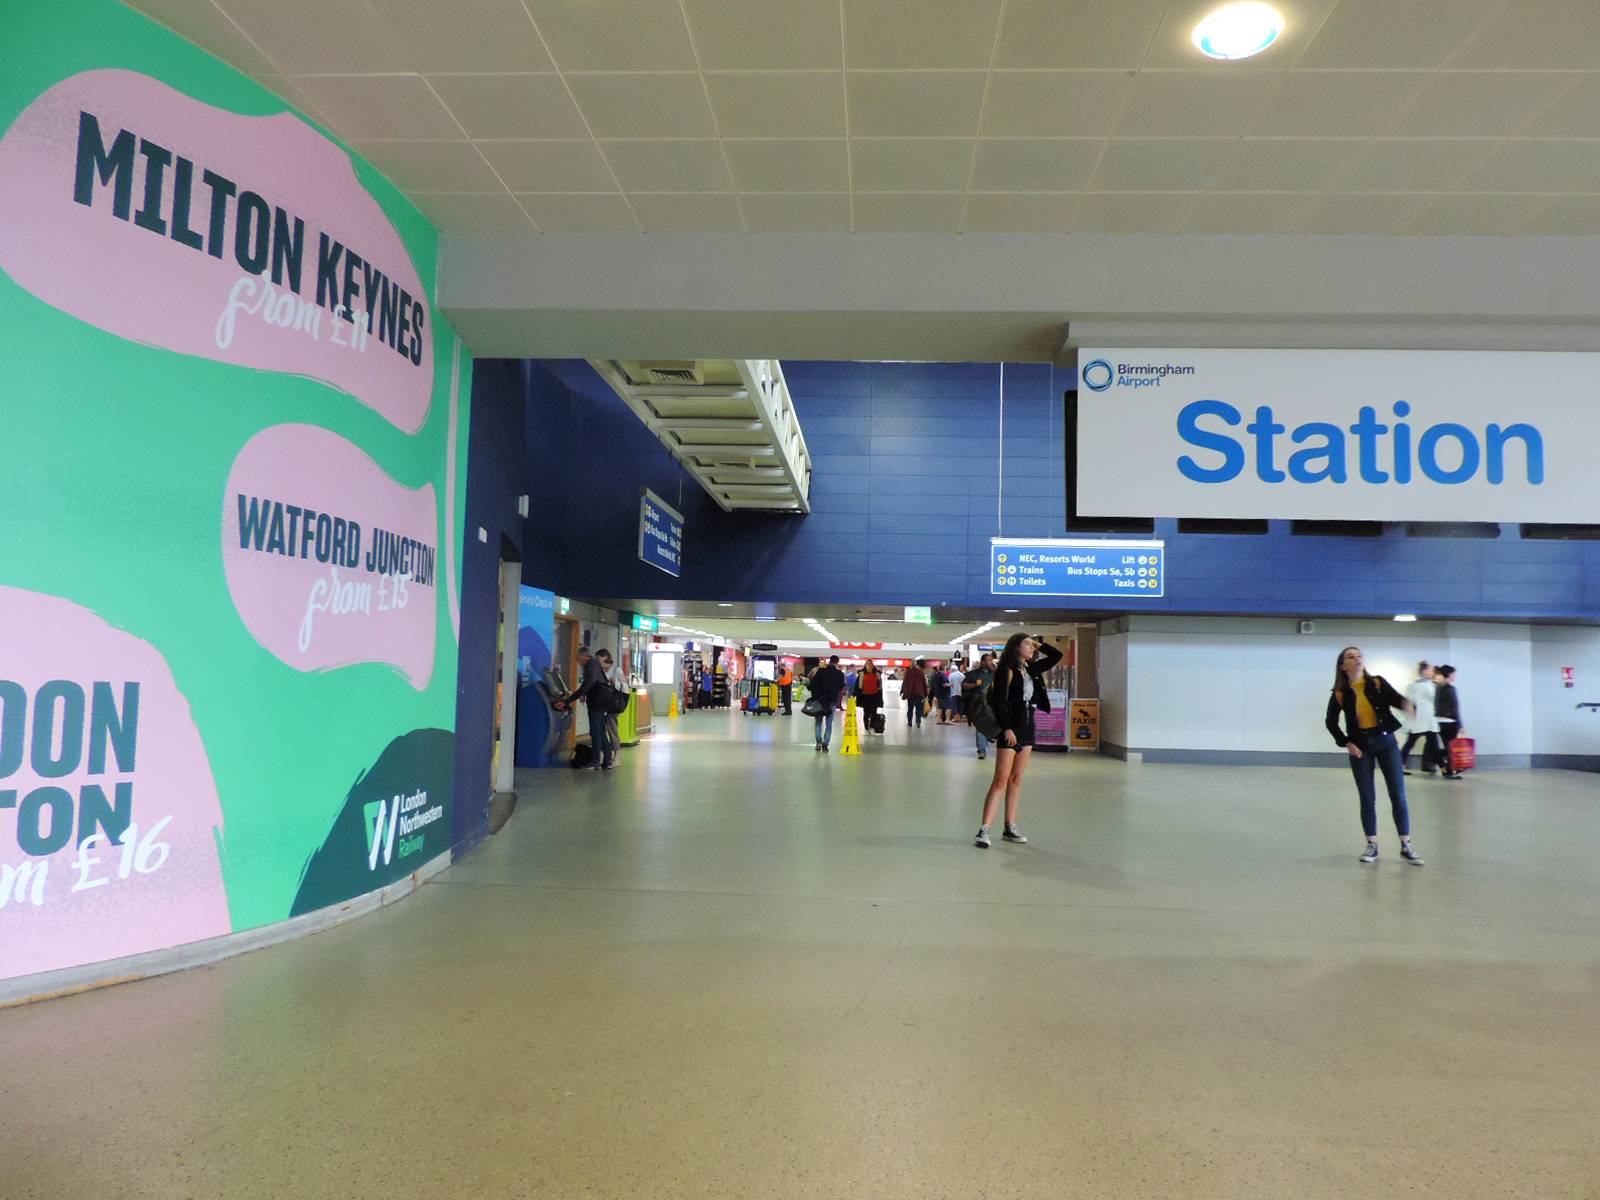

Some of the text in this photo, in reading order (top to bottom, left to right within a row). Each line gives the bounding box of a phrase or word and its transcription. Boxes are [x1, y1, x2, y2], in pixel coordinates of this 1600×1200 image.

[73, 110, 424, 366] MILTON KEYNES
[215, 269, 322, 350] from
[1117, 364, 1195, 377] Birmingham
[1117, 376, 1161, 388] Airport
[1177, 400, 1545, 485] Station
[238, 493, 435, 587] WATFORD JUNCTION
[1019, 555, 1096, 564] NEC, Resorts World
[1121, 556, 1135, 564] Lift
[1019, 566, 1044, 574] Trains
[1067, 567, 1083, 575] Bus
[1084, 567, 1108, 577] Stops
[1019, 577, 1046, 586] Toilets
[1114, 579, 1135, 587] Taxis
[299, 567, 412, 652] from £15
[400, 788, 427, 813] London
[400, 804, 443, 836] Northwestern
[71, 815, 173, 892] £16
